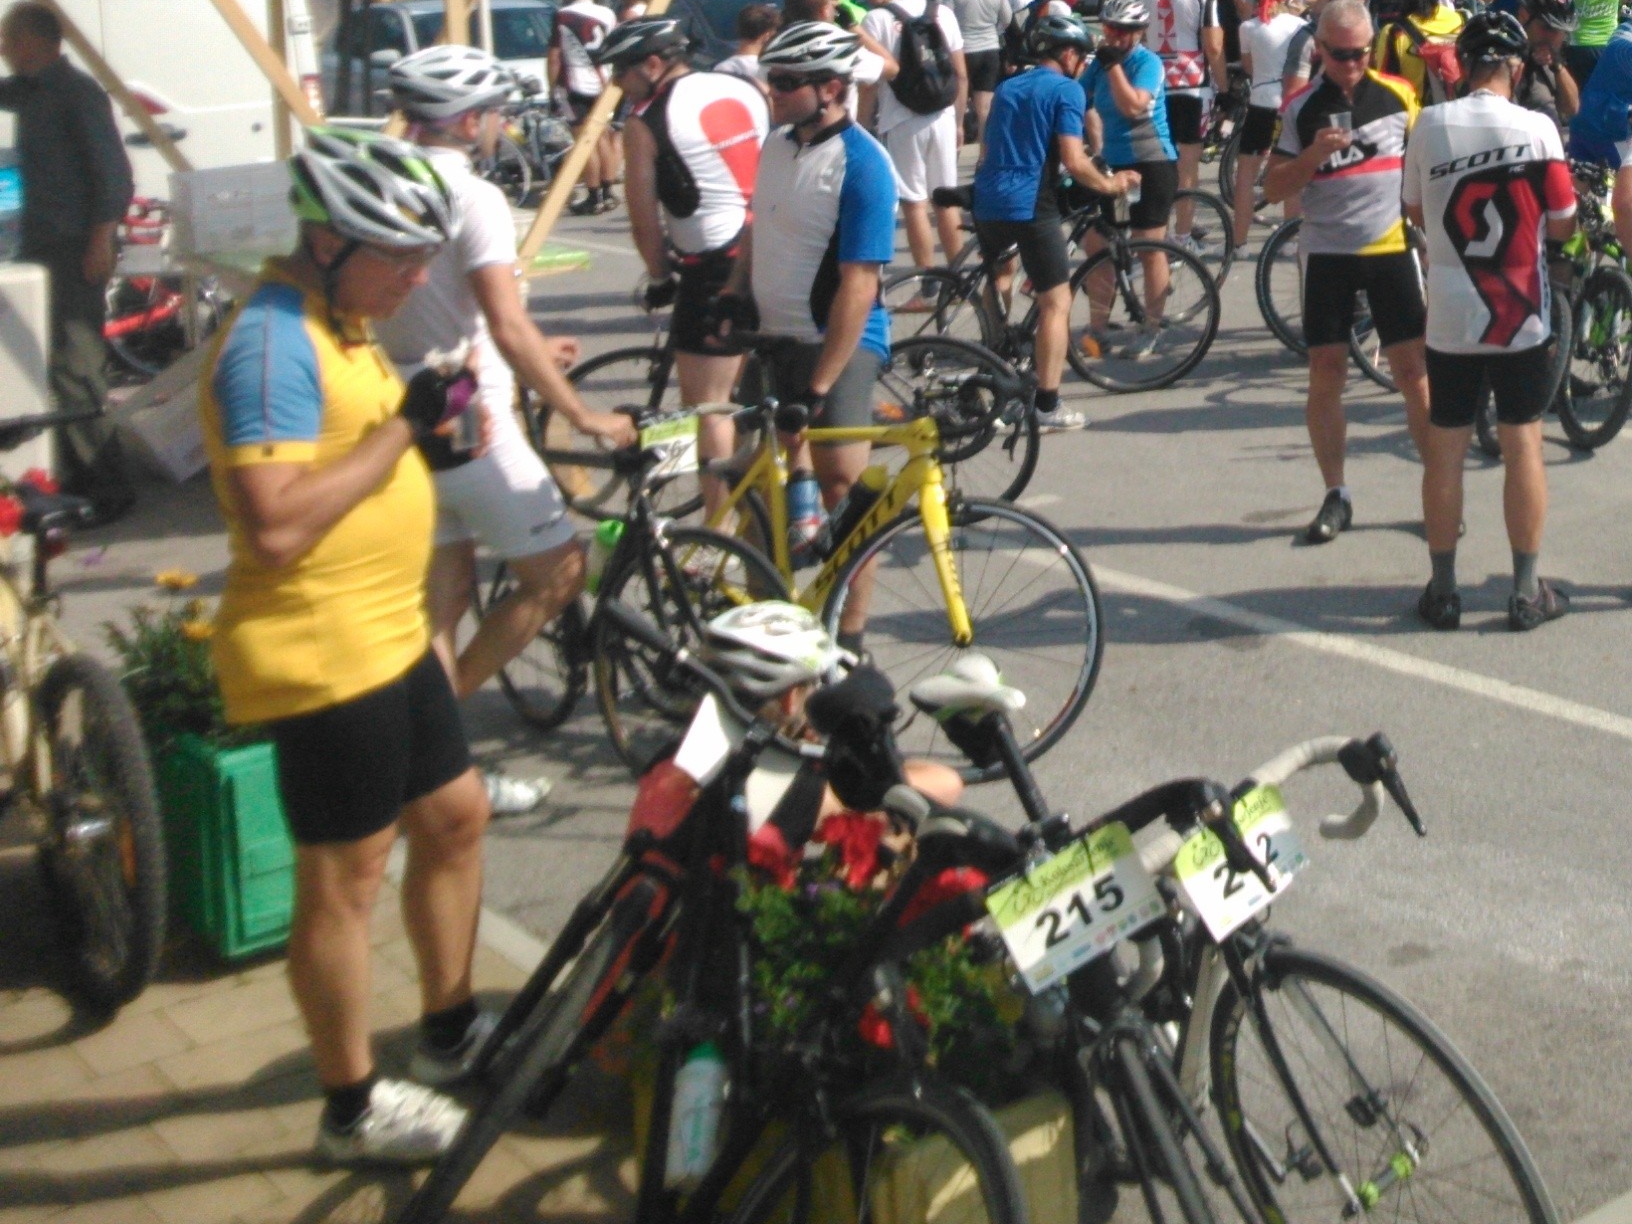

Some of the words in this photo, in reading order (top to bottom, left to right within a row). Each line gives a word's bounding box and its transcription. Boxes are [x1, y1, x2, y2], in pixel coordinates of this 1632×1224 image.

[1429, 143, 1532, 181] SCOTT
[1213, 832, 1279, 900] 22
[1035, 871, 1125, 949] 215
